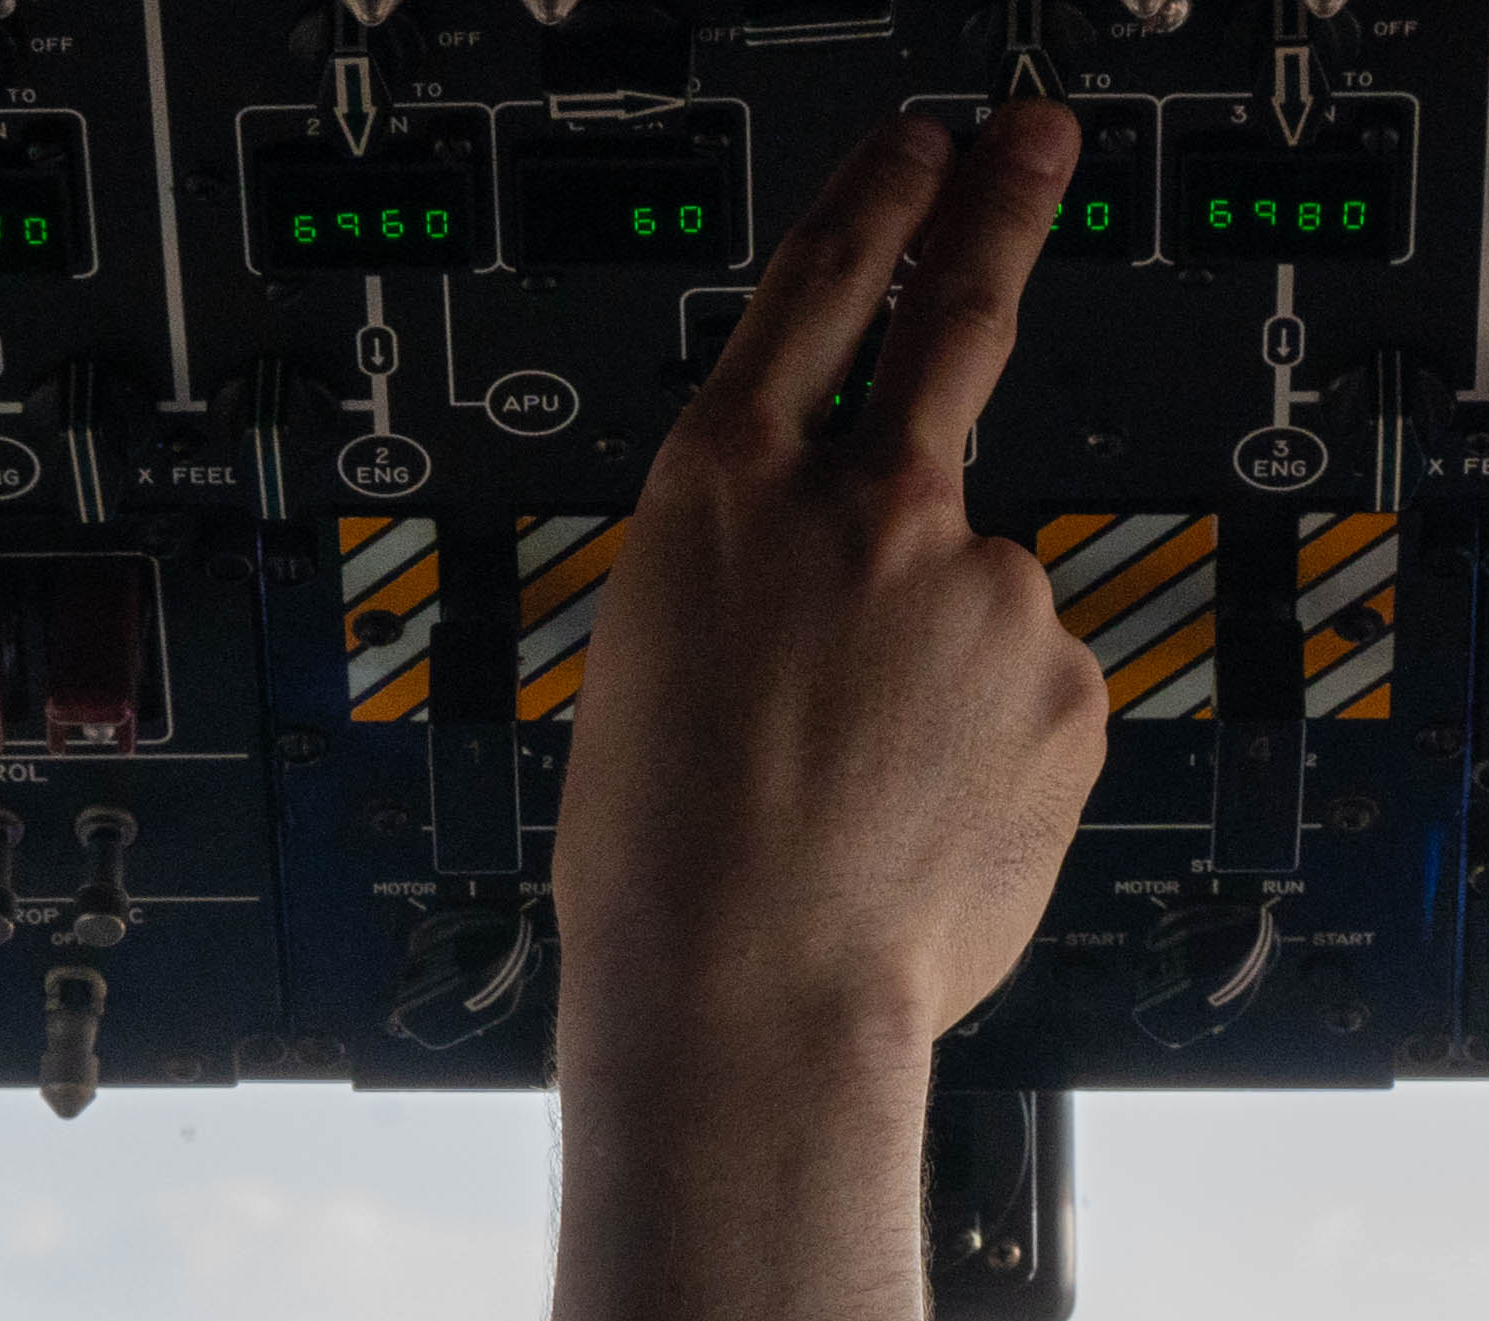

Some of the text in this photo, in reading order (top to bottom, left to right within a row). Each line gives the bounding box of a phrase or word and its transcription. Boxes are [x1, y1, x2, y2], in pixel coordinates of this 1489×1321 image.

[1373, 21, 1417, 38] OFF
[30, 37, 73, 53] OFF
[437, 31, 481, 48] OFF
[633, 205, 703, 236] 60
[1209, 200, 1366, 232] 6980
[293, 209, 449, 243] 6960
[502, 395, 559, 413] APU
[356, 466, 409, 485] ENG
[1253, 459, 1307, 478] ENG
[373, 881, 437, 896] MOTOR
[1115, 880, 1180, 896] MOTOR
[1262, 880, 1305, 895] RUN
[1066, 931, 1127, 948] START
[1313, 931, 1376, 948] START
